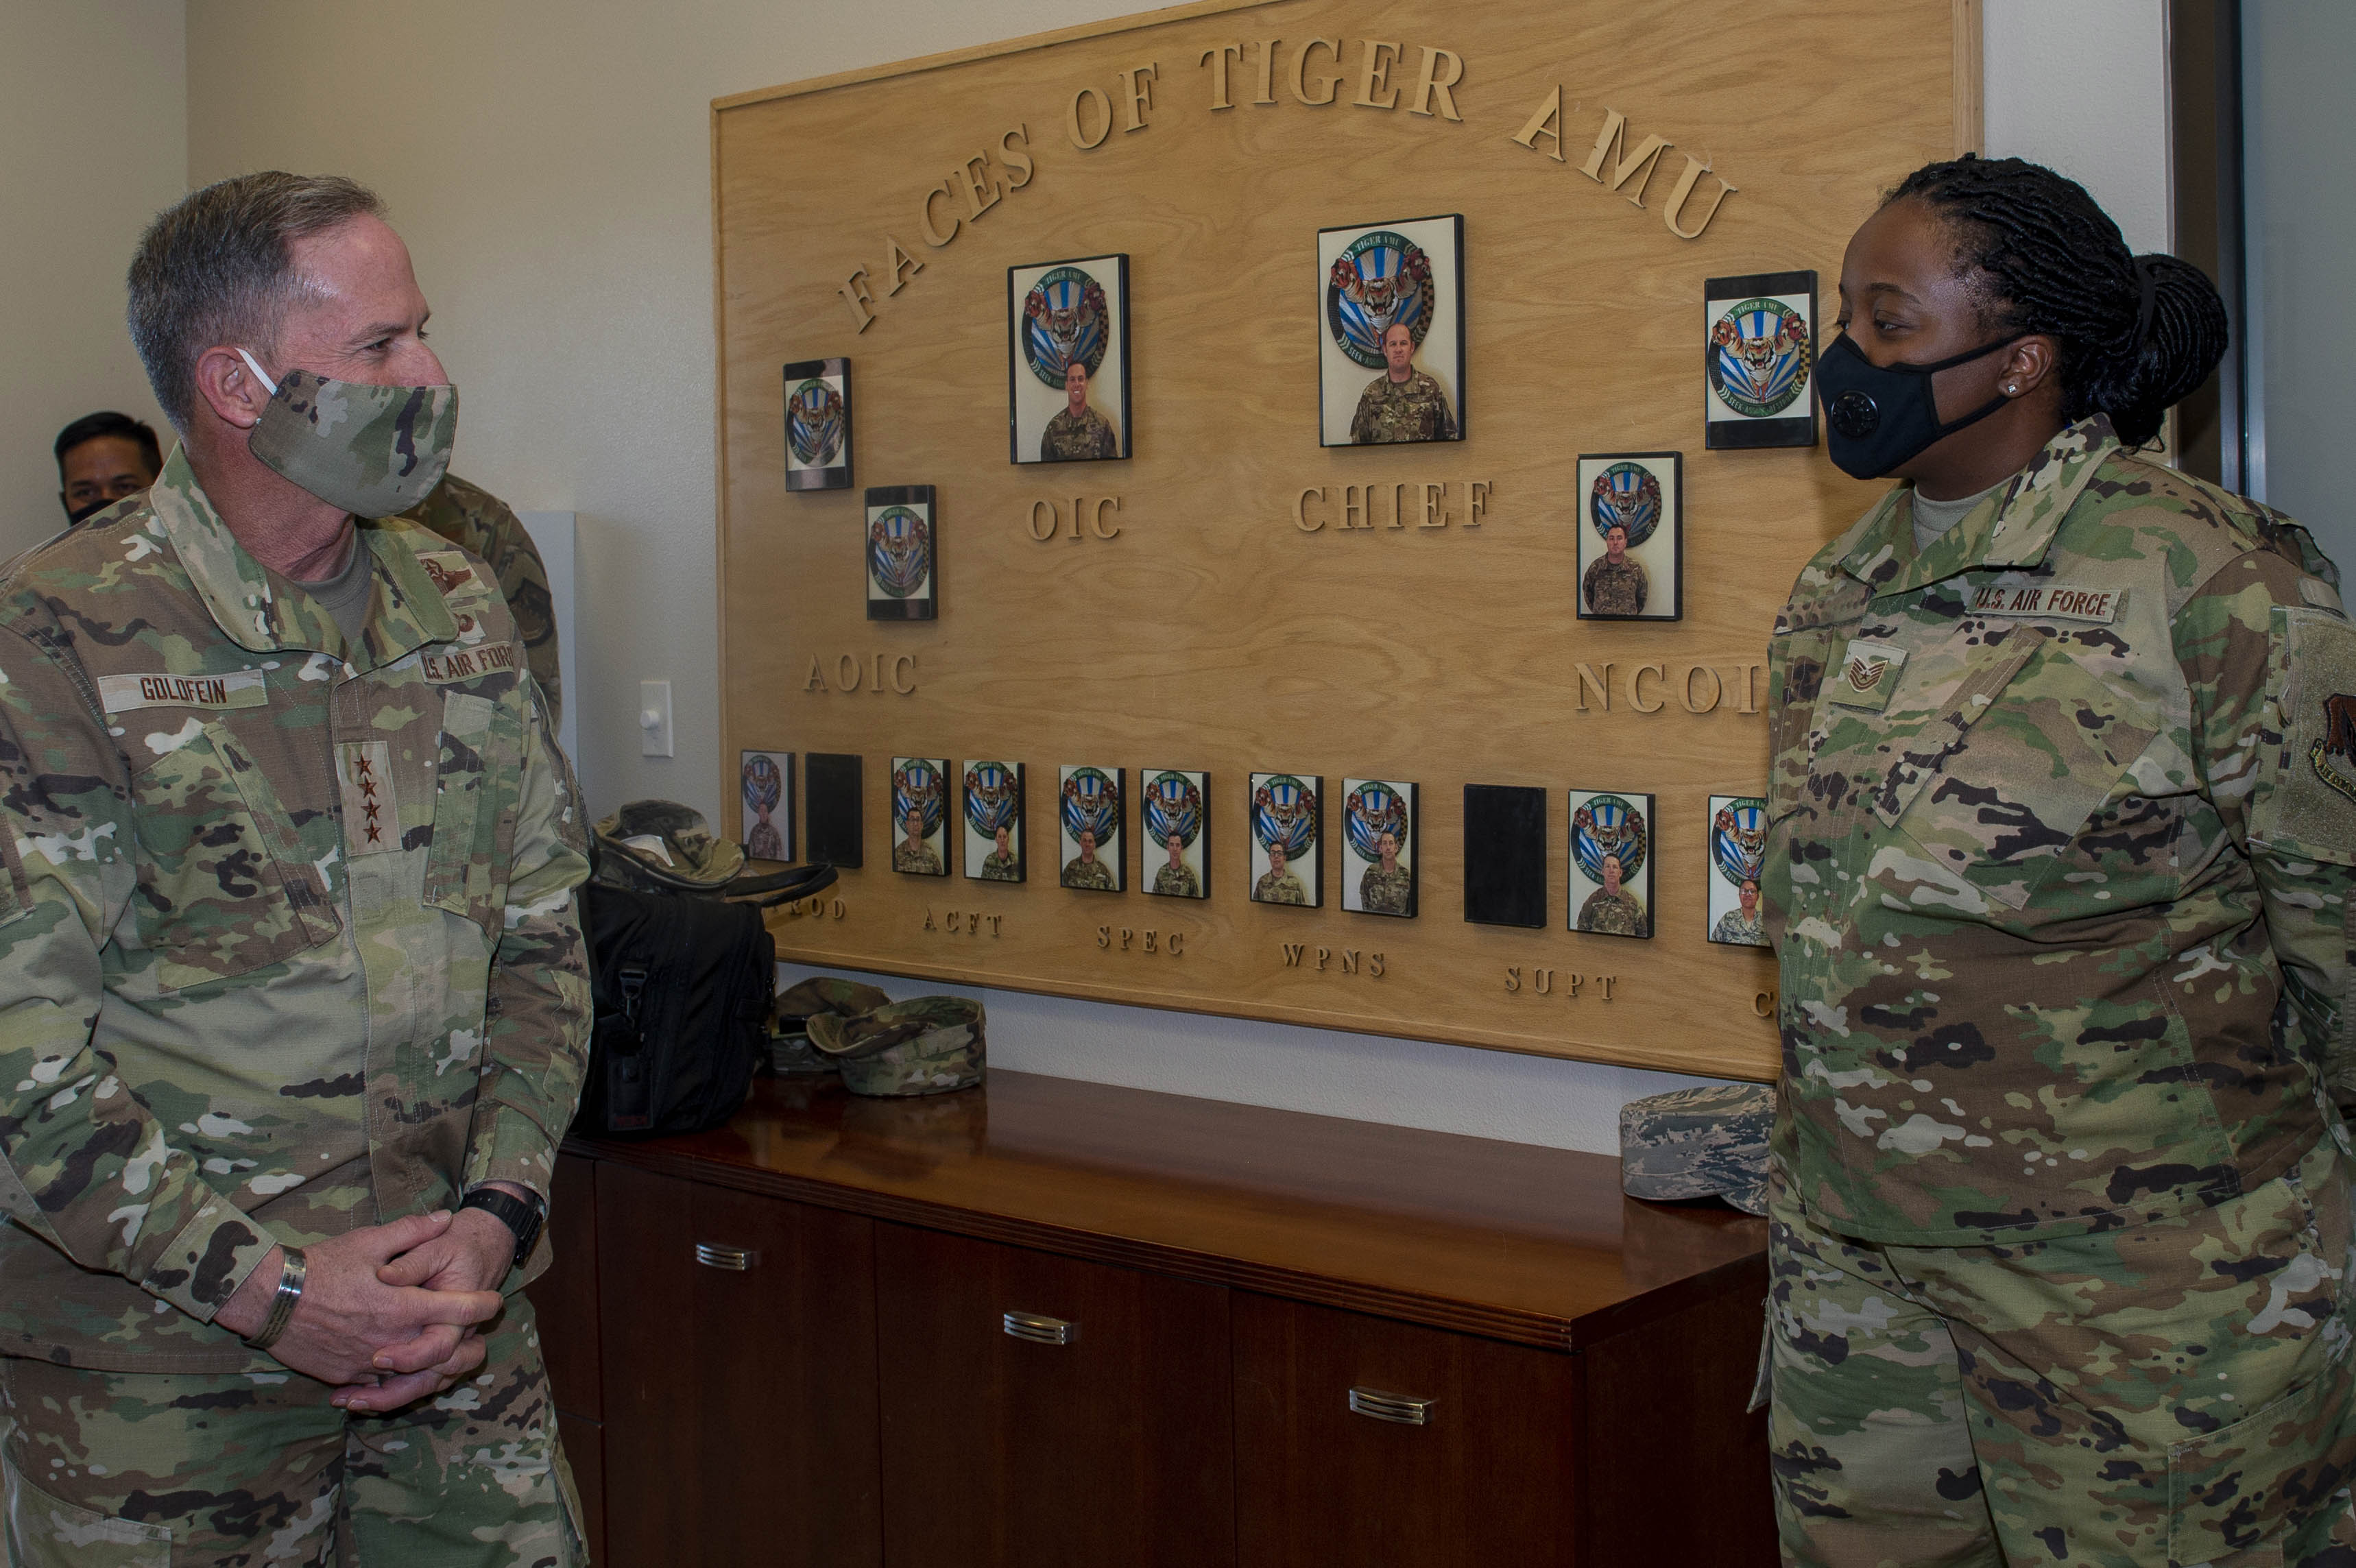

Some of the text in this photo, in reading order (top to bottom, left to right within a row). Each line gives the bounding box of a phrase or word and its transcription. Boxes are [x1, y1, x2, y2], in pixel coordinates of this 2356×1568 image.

[838, 38, 1738, 334] FACES OF TIGER AMU
[1031, 495, 1121, 541] OIC
[1292, 480, 1493, 532] CHIEF
[1975, 588, 2112, 616] U.S. AIR FORCE
[446, 653, 477, 679] AIR
[803, 652, 917, 695] AOIC
[139, 677, 228, 704] GOLDFEIN
[772, 897, 845, 919] ROD
[922, 908, 1003, 937] ACFT
[1097, 926, 1186, 955] SPEC
[1279, 942, 1386, 978] WPNS
[1505, 966, 1617, 1001] SUPT
